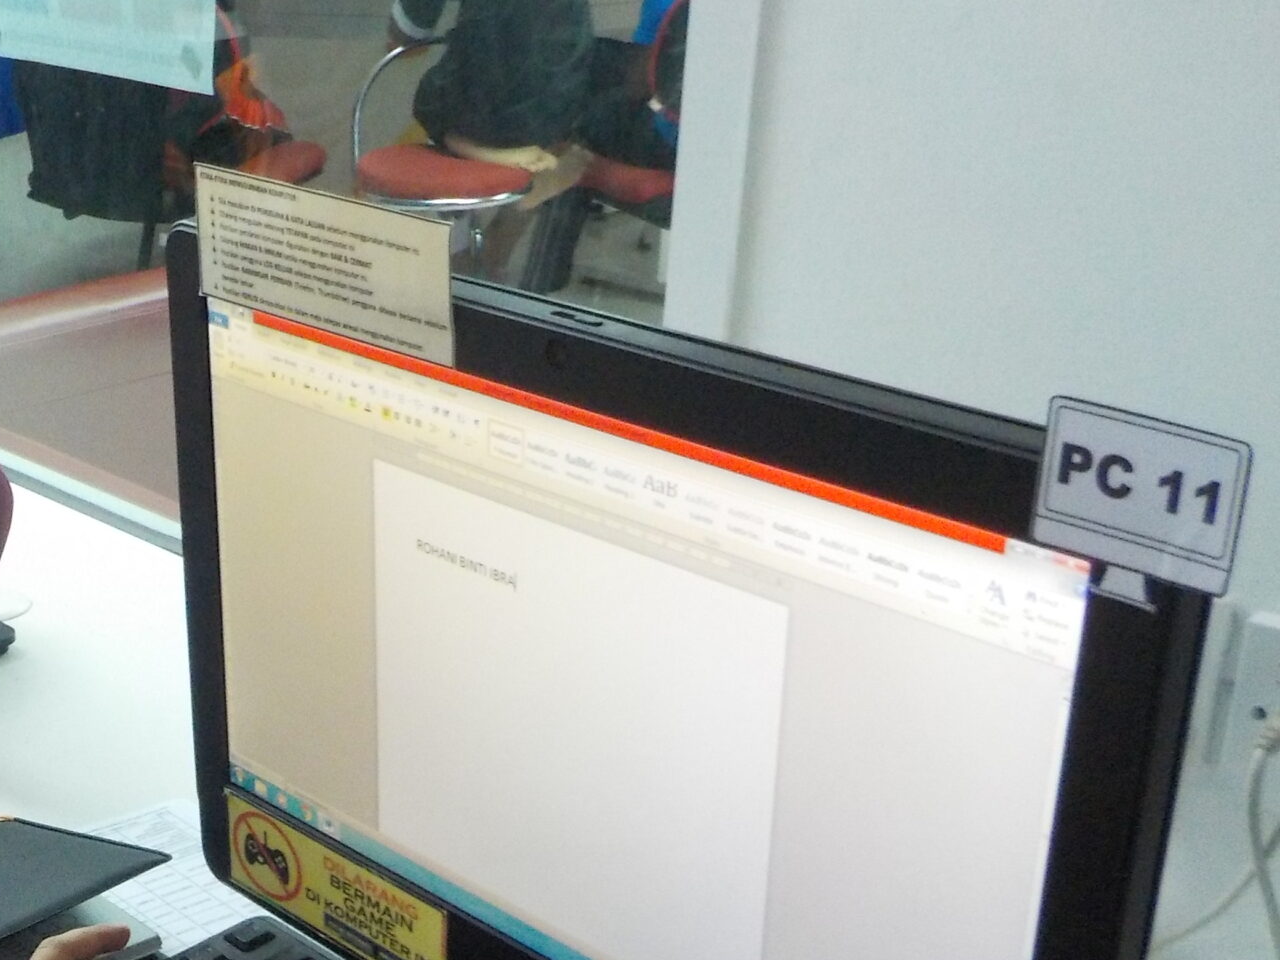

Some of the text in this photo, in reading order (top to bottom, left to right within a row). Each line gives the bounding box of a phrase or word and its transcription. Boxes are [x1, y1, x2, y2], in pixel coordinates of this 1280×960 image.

[1057, 441, 1222, 526] PC 11
[305, 887, 320, 905] DI
[324, 898, 411, 958] KOMPUTER
[330, 874, 414, 933] BERMAIN
[343, 897, 396, 938] GAME
